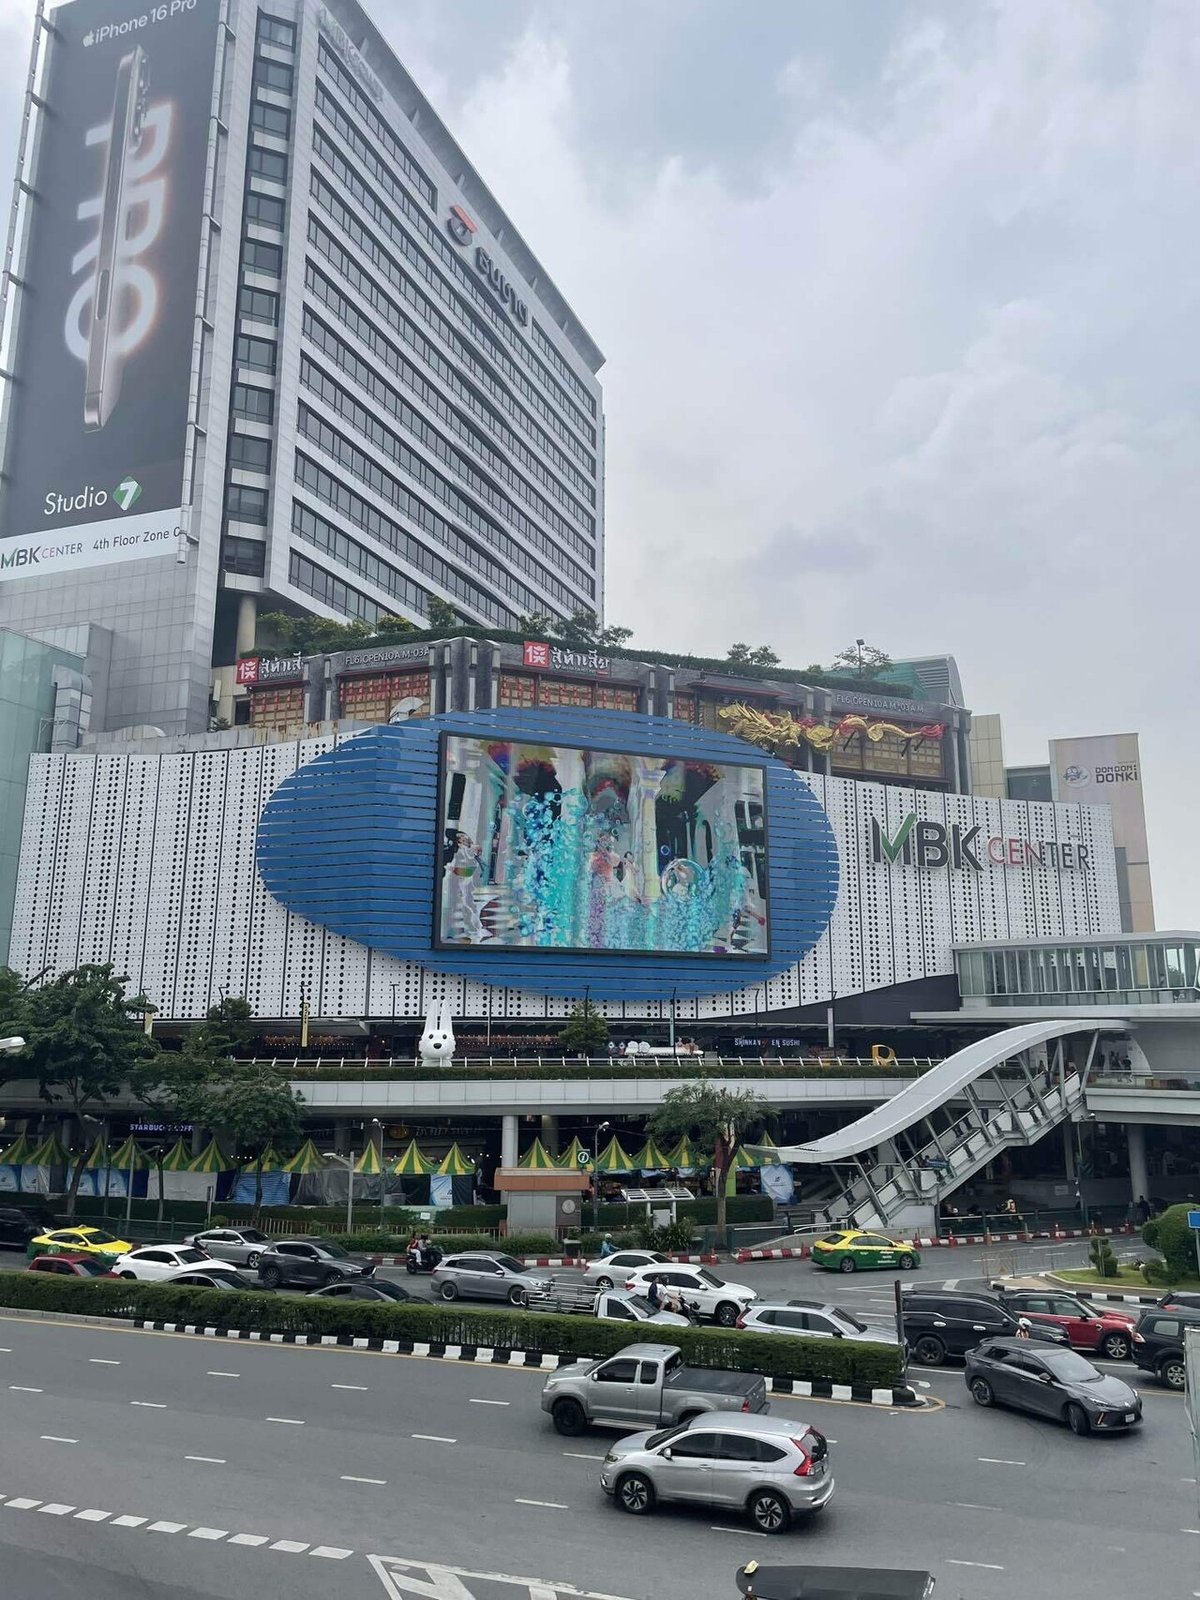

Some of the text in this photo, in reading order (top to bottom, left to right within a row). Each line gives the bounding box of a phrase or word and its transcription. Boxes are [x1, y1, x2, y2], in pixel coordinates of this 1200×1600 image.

[95, 0, 197, 44] iPhone 16 Pro
[44, 480, 139, 516] Studio 7
[0, 545, 42, 569] MBK
[41, 542, 83, 559] CENTER
[93, 538, 110, 551] 4th
[113, 534, 140, 548] Floor
[143, 529, 170, 543] Zone
[1095, 772, 1138, 783] DONKI
[871, 813, 1091, 871] MBK CENTER
[782, 1039, 801, 1047] SUSHI
